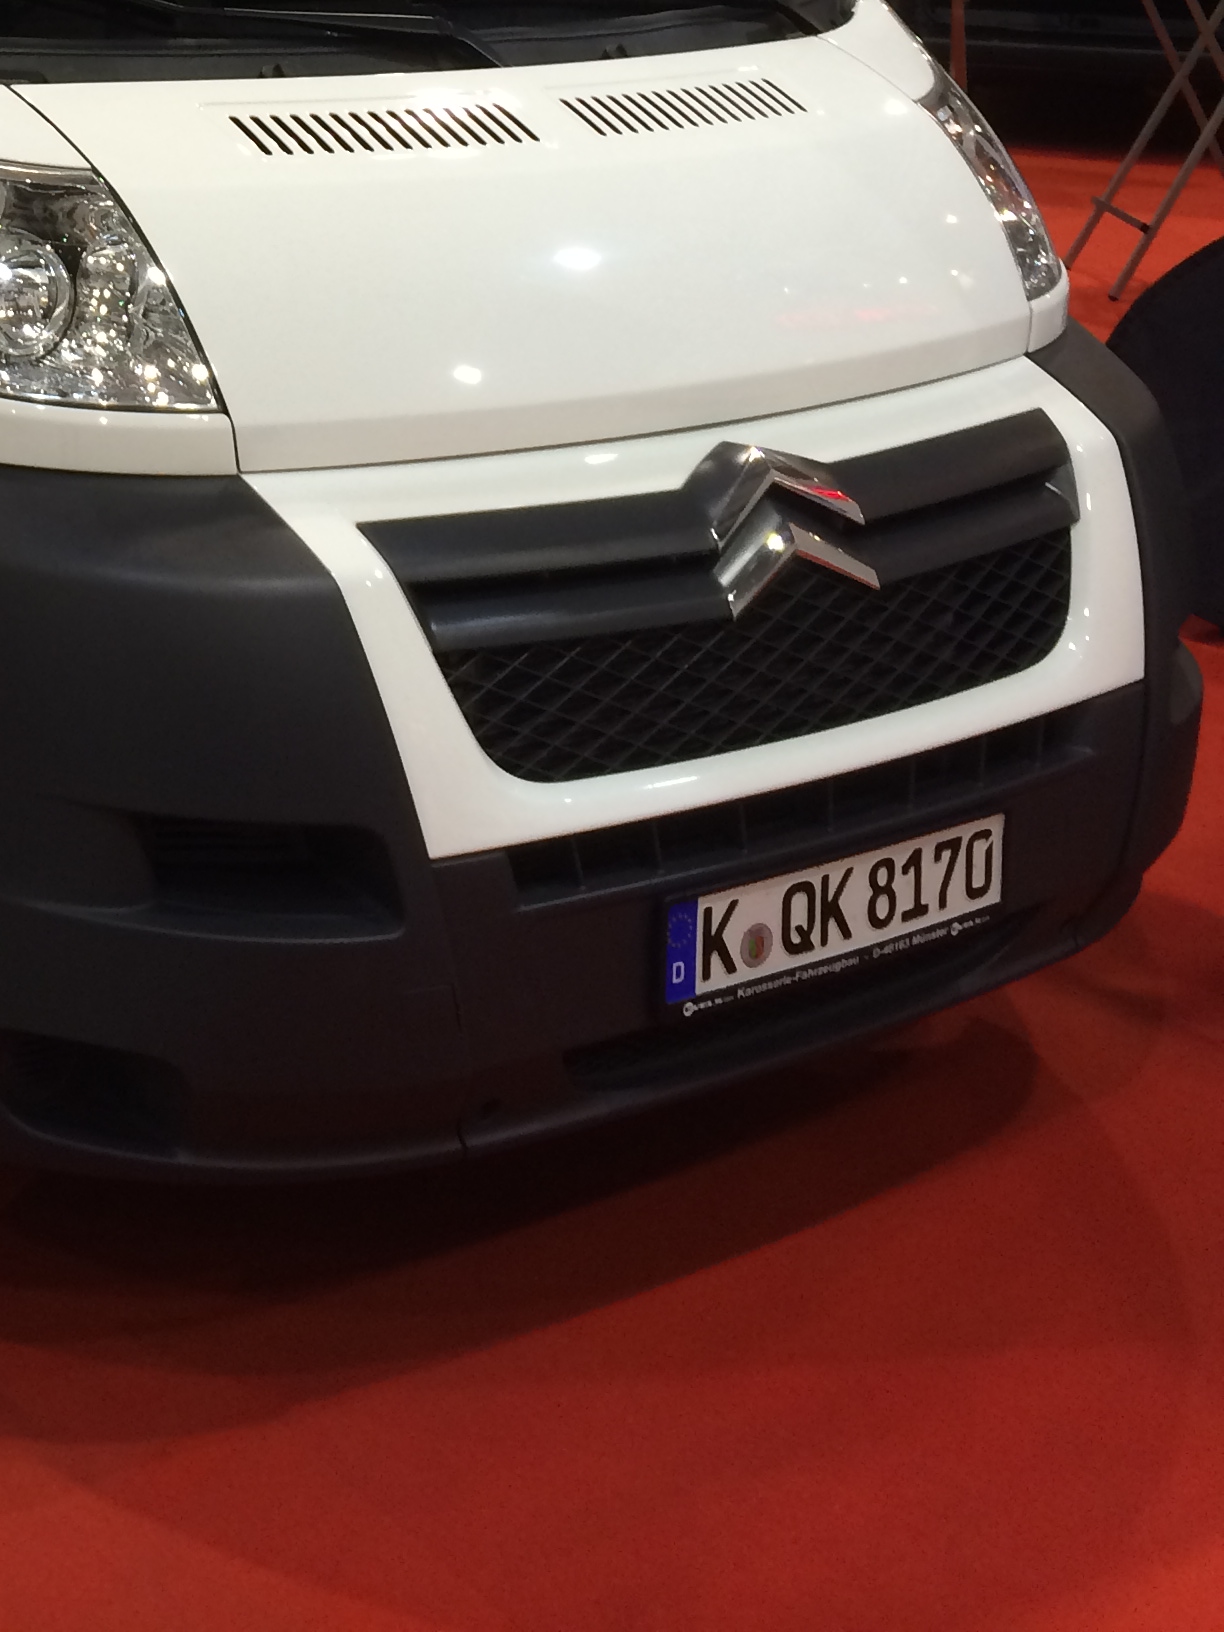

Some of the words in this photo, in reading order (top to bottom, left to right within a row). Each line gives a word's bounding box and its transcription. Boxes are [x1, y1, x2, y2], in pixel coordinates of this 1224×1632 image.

[672, 961, 685, 984] D
[701, 899, 739, 982] K
[781, 867, 854, 955] QK
[867, 828, 993, 930] 8170
